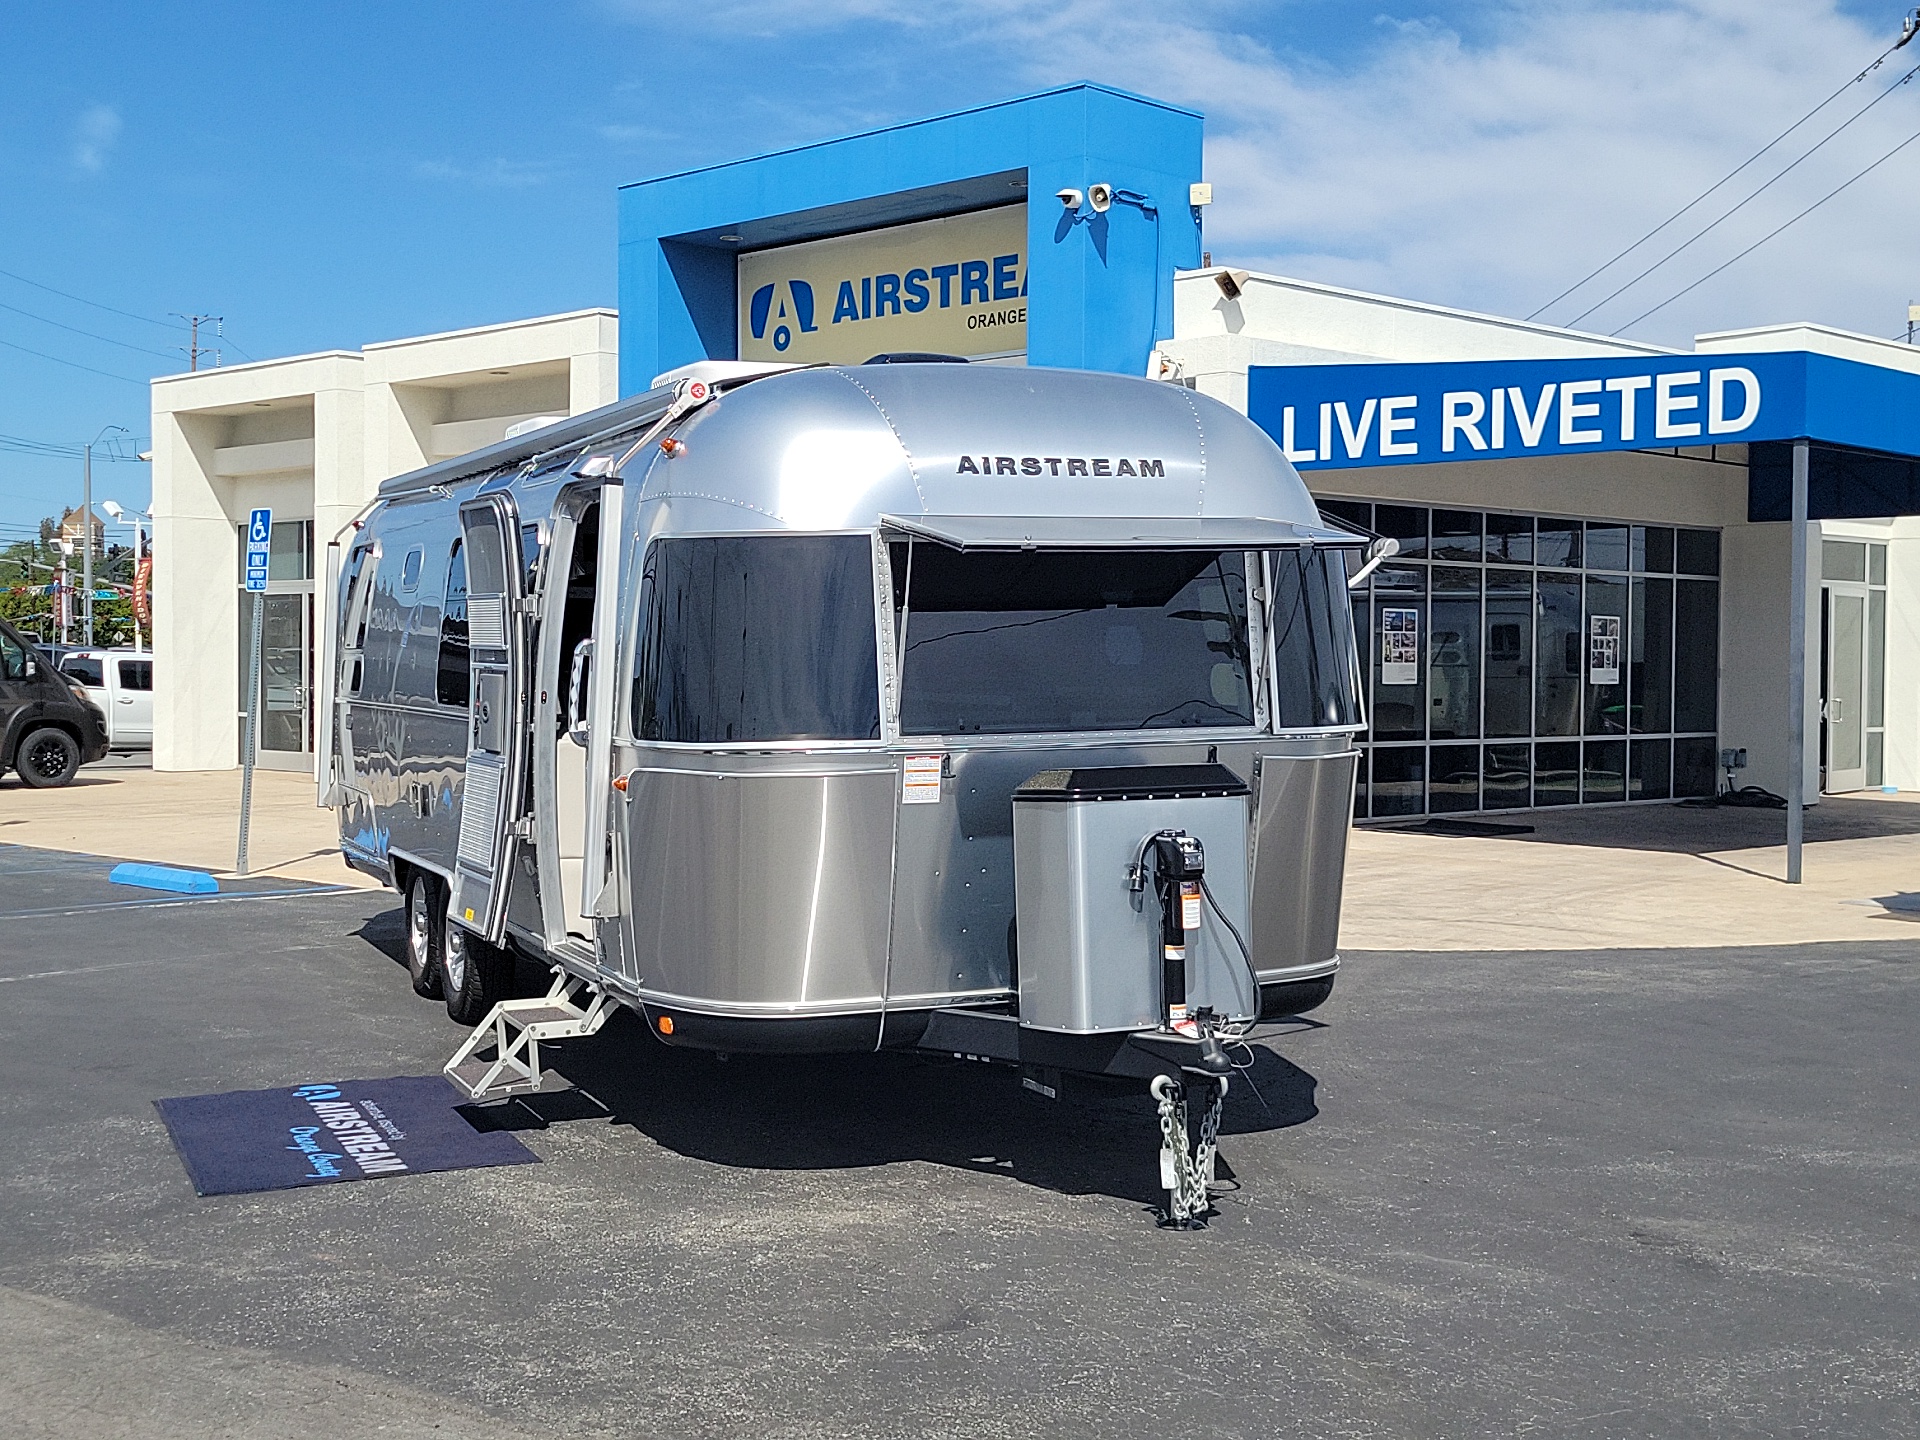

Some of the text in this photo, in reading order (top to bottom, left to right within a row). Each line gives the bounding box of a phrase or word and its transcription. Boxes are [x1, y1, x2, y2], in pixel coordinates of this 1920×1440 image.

[832, 253, 1028, 324] AIRSTRE
[967, 308, 1027, 330] ORANGE
[1283, 367, 1761, 463] LIVE RIVETED
[956, 455, 1165, 478] AIRSTREAM
[308, 1101, 409, 1174] AIRSTREAM
